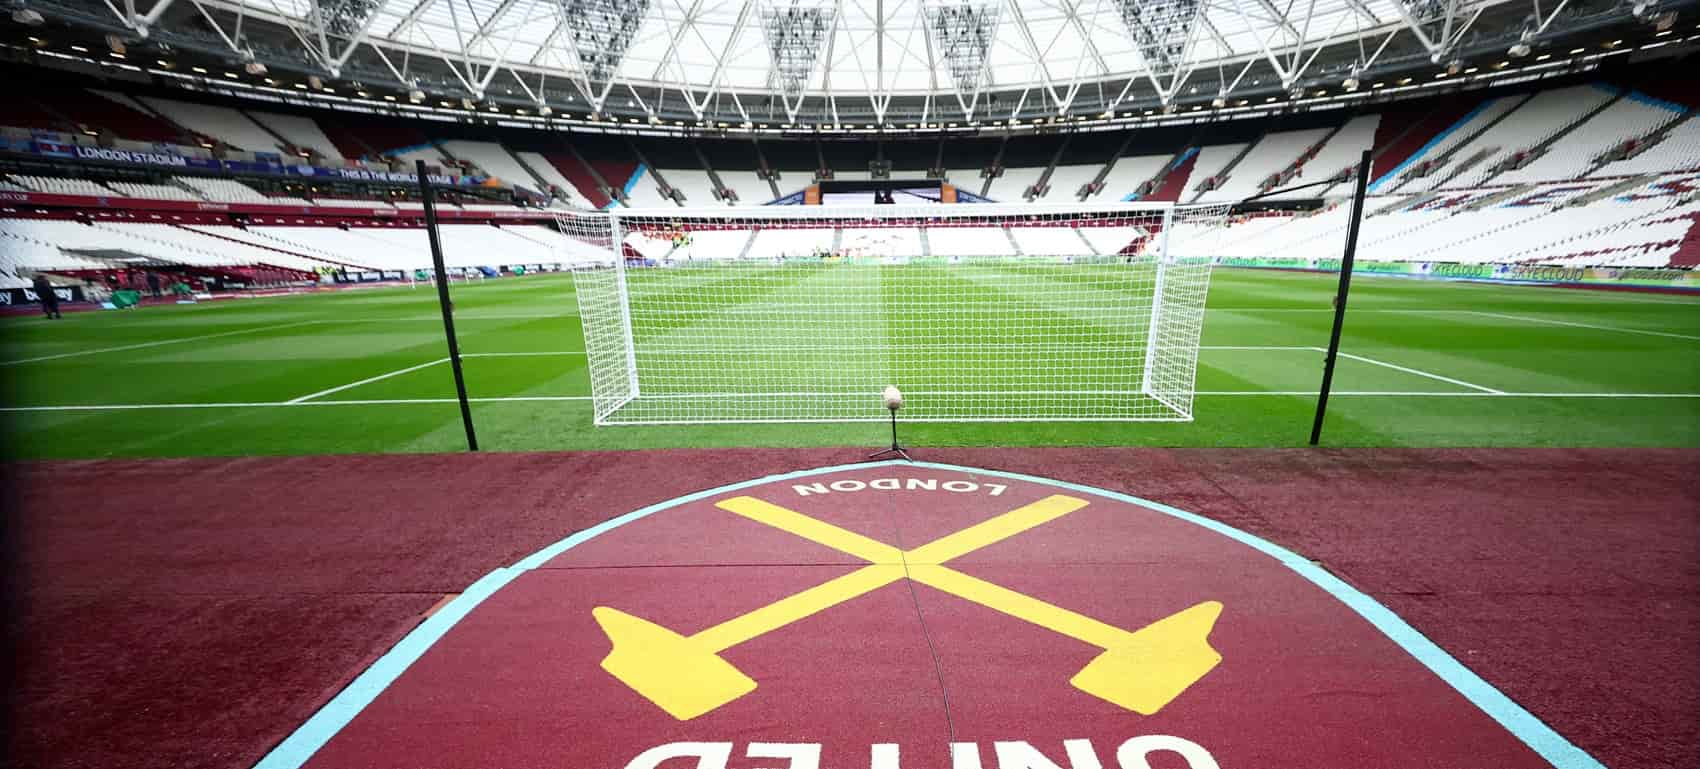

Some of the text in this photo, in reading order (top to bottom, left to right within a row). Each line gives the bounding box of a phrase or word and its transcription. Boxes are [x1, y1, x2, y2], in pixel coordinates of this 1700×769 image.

[76, 146, 186, 166] LONDON STADIUM
[340, 169, 452, 184] THIS IS THE WORLD TAGE
[1432, 263, 1483, 276] SKYECLOUD
[1512, 265, 1582, 280] SKYECLOUD
[792, 477, 1008, 497] LONDON
